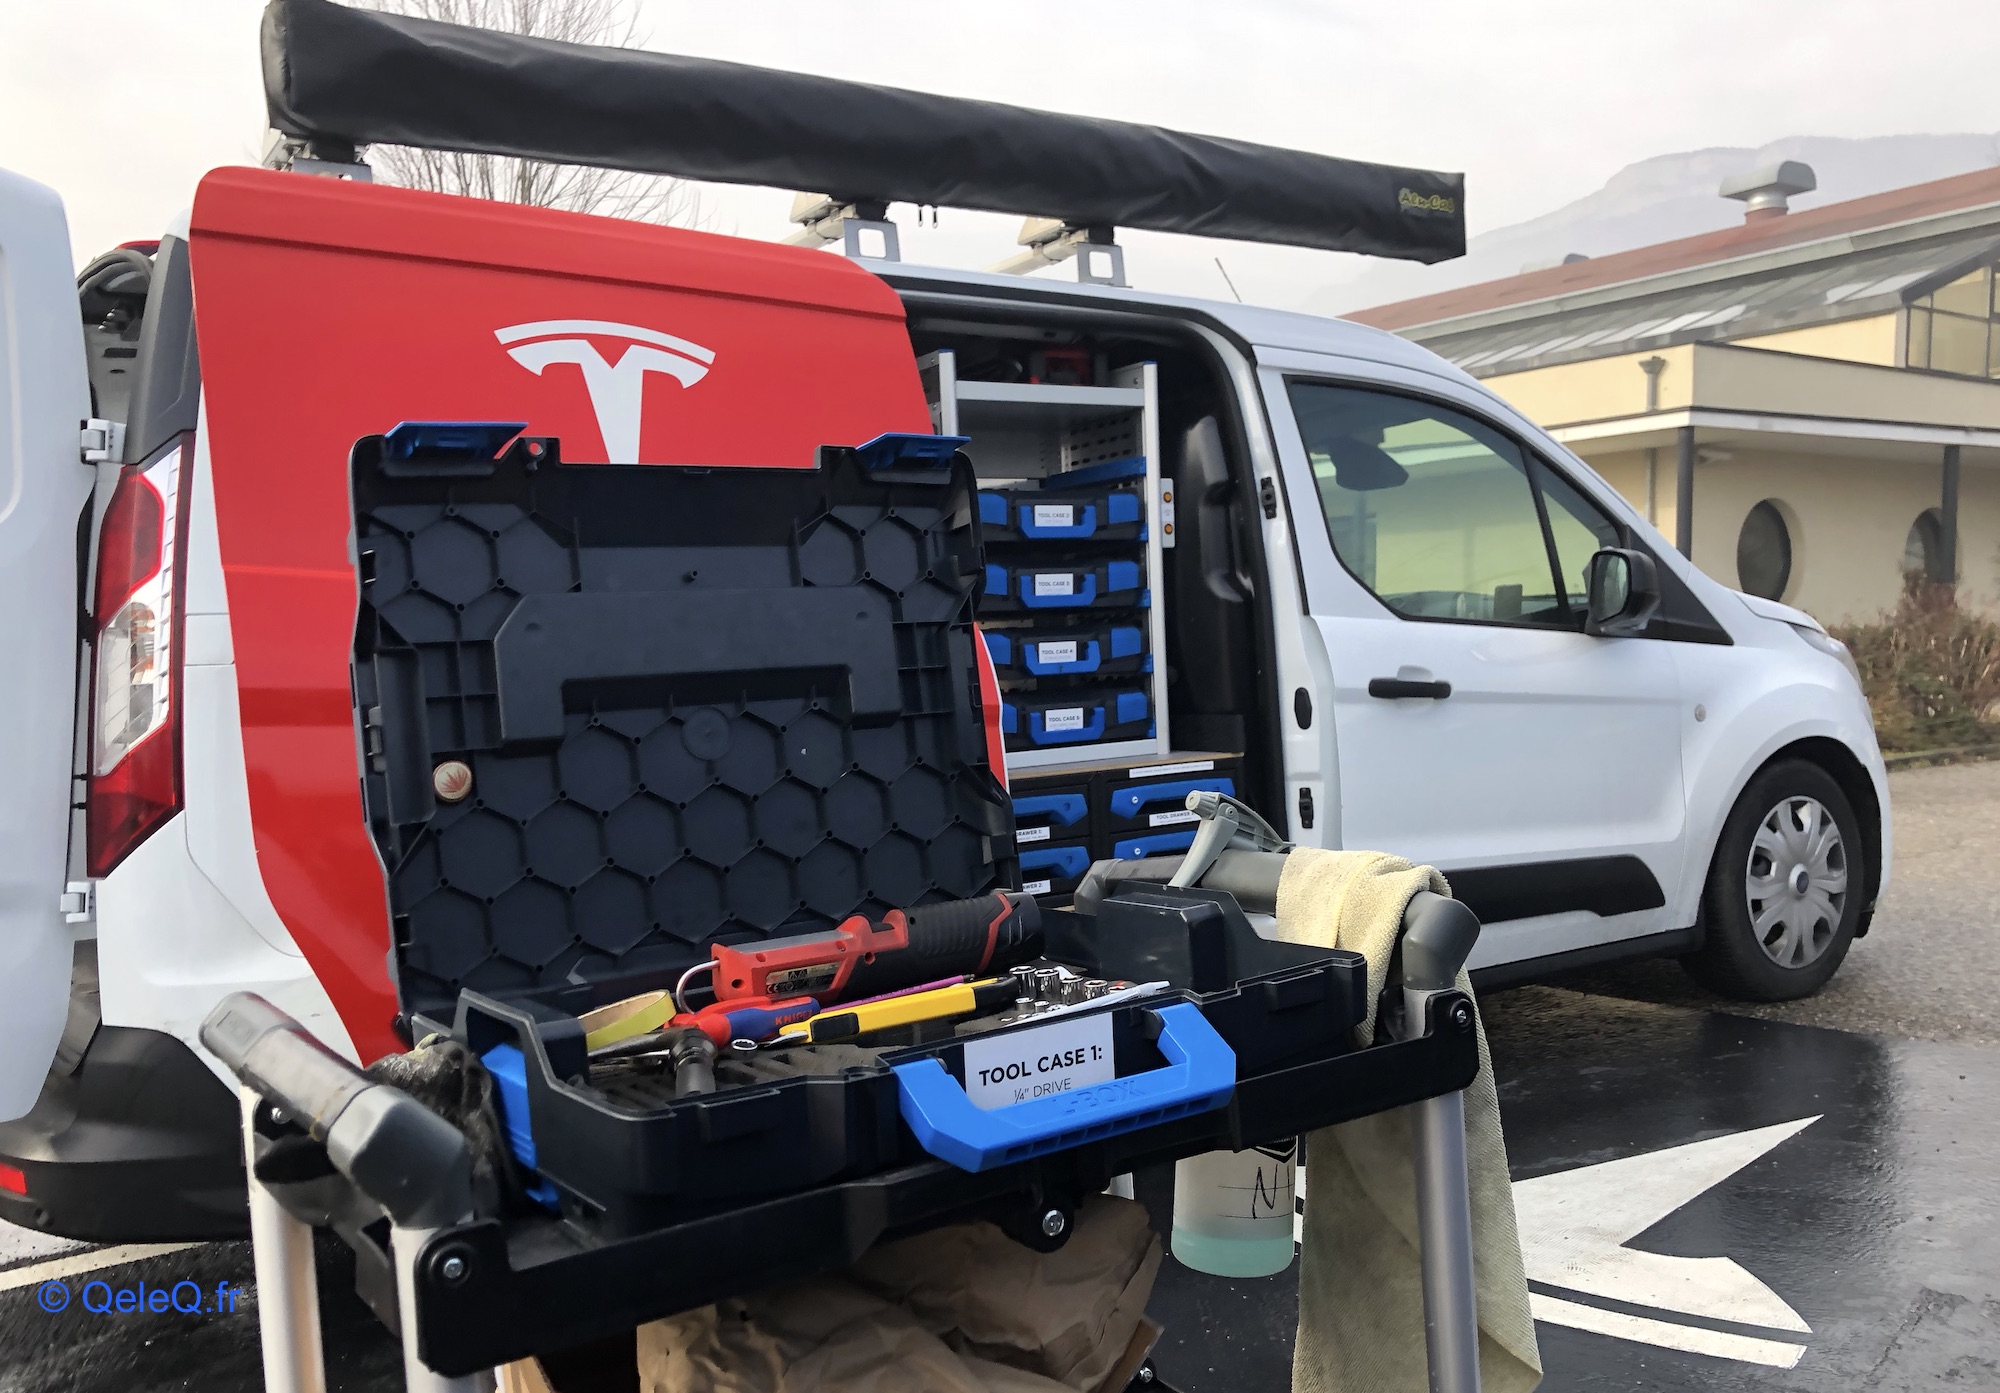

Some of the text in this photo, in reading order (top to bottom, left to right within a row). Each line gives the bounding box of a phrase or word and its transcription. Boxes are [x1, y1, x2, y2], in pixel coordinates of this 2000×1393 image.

[979, 1045, 1102, 1086] TOOL CASE 1:
[1033, 1077, 1071, 1098] DRIVE
